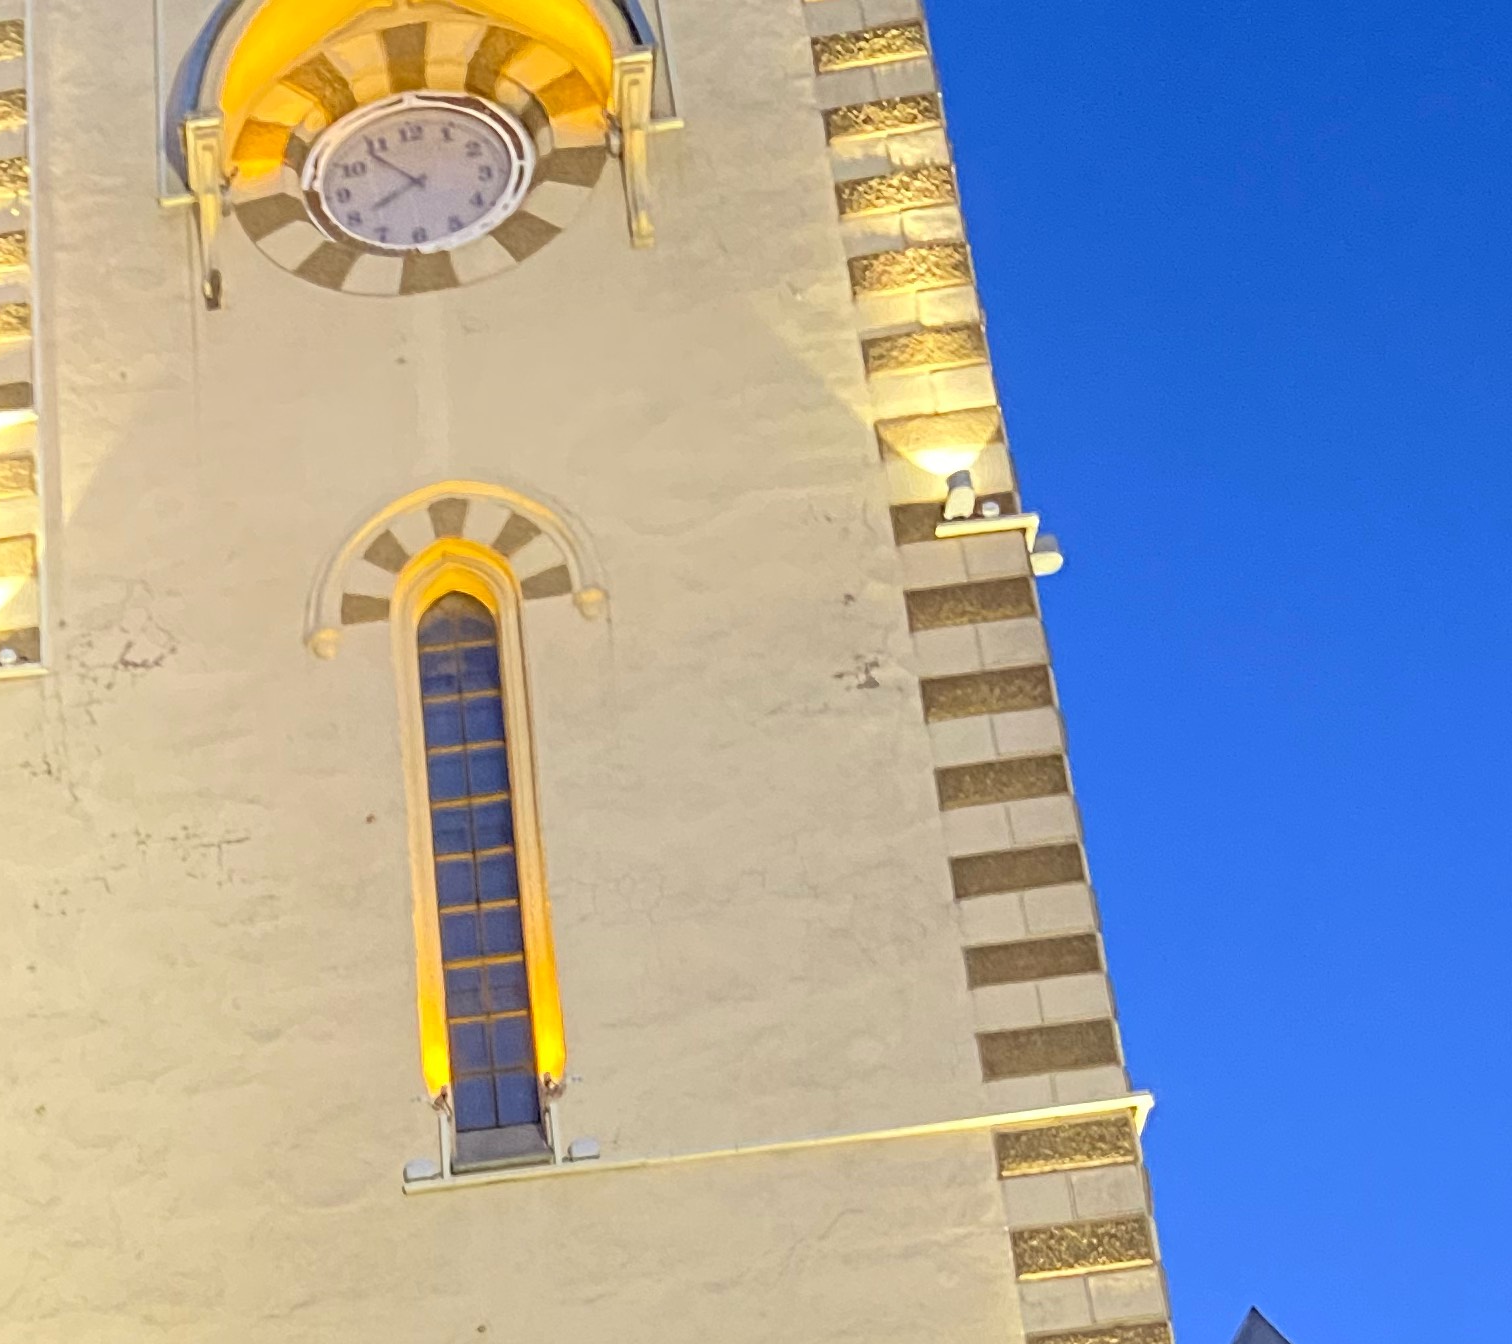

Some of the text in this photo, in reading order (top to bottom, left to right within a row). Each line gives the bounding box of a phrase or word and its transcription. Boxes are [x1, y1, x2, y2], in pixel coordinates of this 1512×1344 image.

[399, 124, 423, 142] 12
[441, 127, 454, 142] 1
[465, 140, 482, 157] 2
[343, 161, 366, 177] 10
[478, 165, 492, 181] 3
[336, 188, 350, 203] 9
[412, 227, 428, 243] 6
